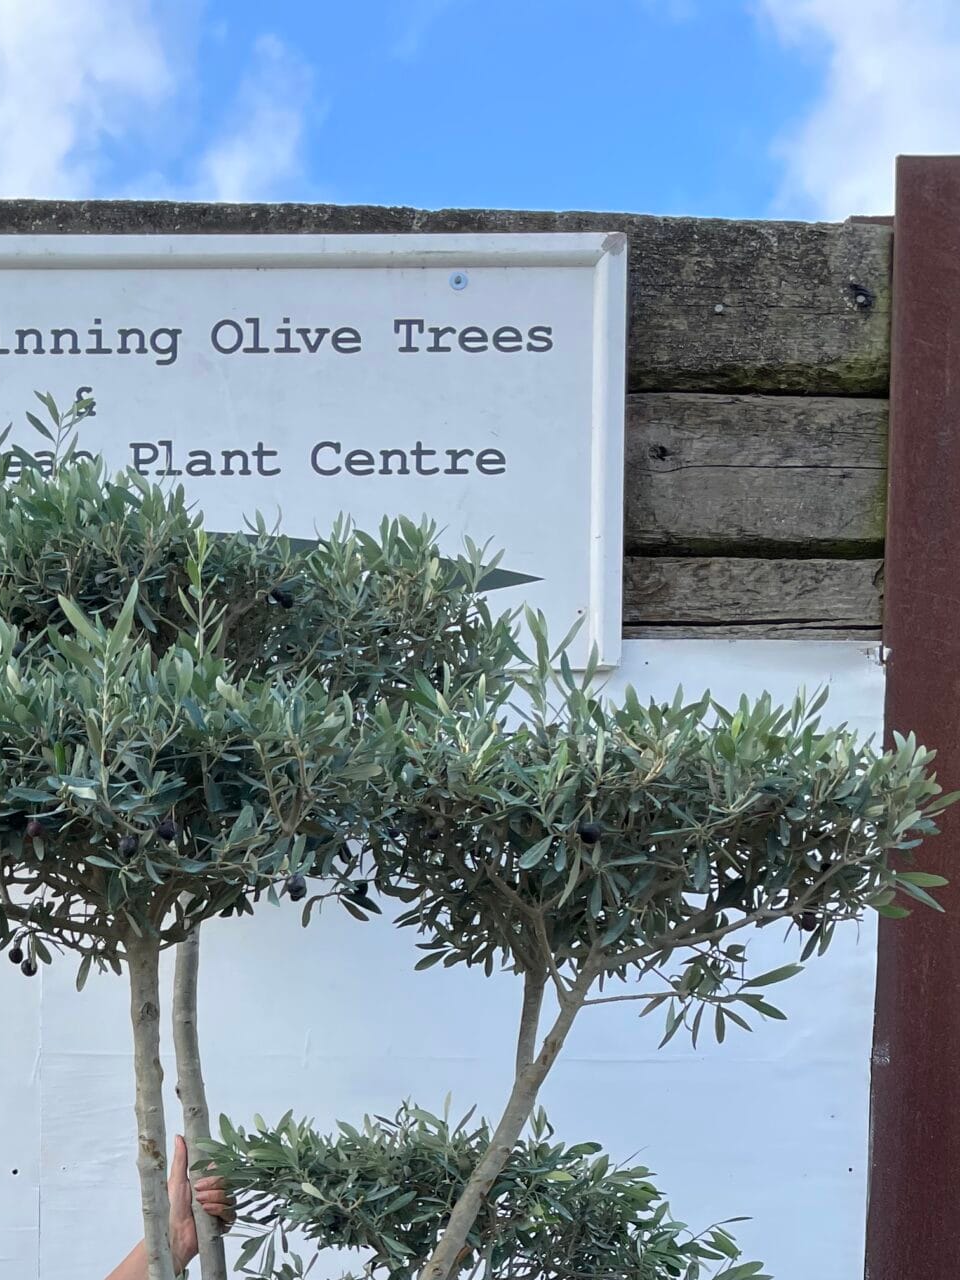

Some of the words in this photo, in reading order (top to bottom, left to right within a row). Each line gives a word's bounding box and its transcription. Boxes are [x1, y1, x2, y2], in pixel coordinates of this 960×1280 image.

[211, 317, 363, 355] Olive
[393, 318, 555, 354] Trees
[129, 440, 282, 478] Plant
[310, 440, 508, 477] Centre
